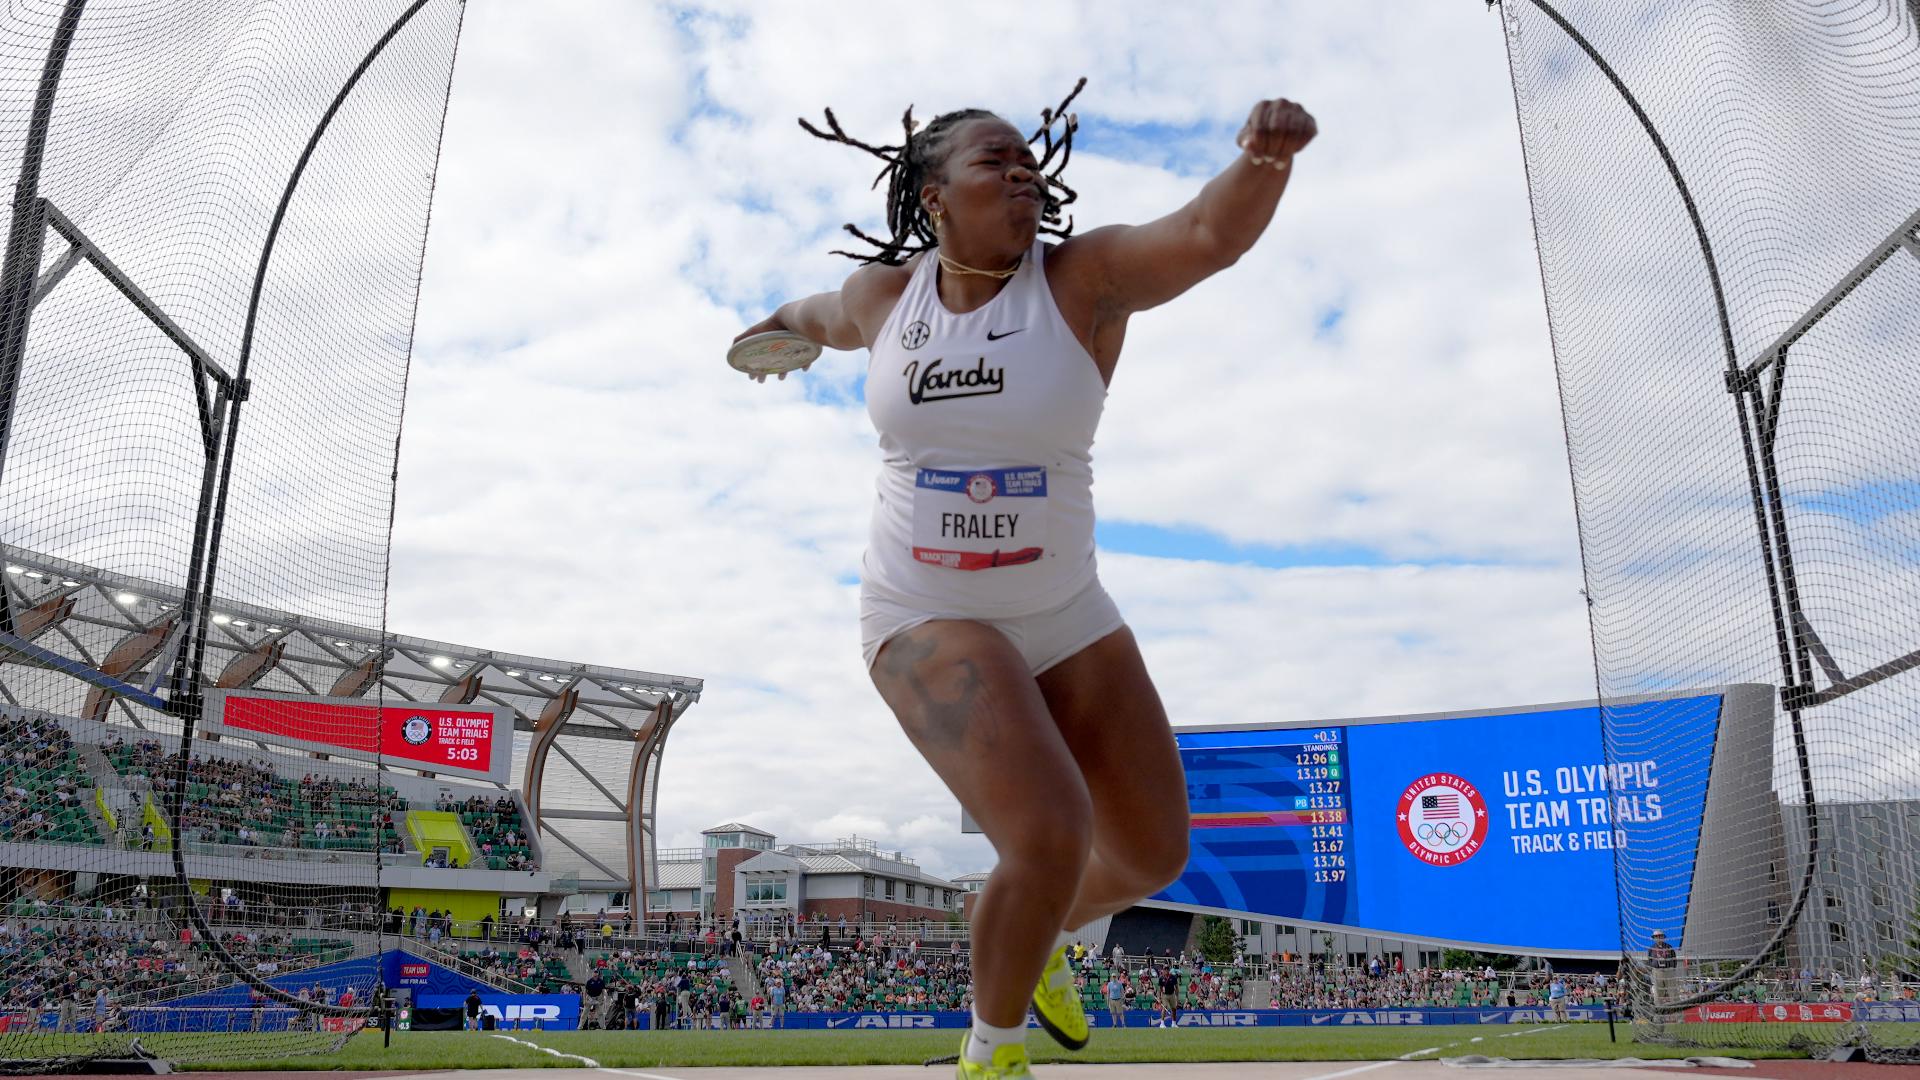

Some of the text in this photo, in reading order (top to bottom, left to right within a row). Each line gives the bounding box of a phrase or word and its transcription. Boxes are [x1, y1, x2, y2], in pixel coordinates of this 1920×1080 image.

[903, 357, 1004, 405] Vandy
[941, 512, 1019, 538] FRALEY
[438, 717, 490, 728] U.S. OLYMPIC
[438, 727, 489, 738] TEAM TRIALS
[1313, 731, 1337, 742] +0.3
[447, 747, 478, 760] 5:03
[1303, 743, 1338, 752] STANDINGS
[1295, 753, 1327, 765] 12.96
[1296, 767, 1328, 780] 13.19
[1503, 760, 1659, 798] U.S. OLYMPIC
[1309, 781, 1340, 794] 13.27
[1404, 775, 1476, 801] UNITED STATES
[1310, 795, 1342, 808] 13.33
[1311, 811, 1343, 823] 13.38
[1505, 794, 1663, 829] TEAM TRIALS
[1312, 825, 1343, 838] 13.41
[1313, 840, 1344, 853] 13.67
[1511, 830, 1627, 854] TRACK & FIELD
[1409, 839, 1479, 864] OLYMPIC TEAM
[1313, 855, 1345, 868] 13.76
[1314, 870, 1346, 882] 13.97
[476, 1004, 561, 1022] AIR
[1177, 1013, 1258, 1026] AIR
[1340, 1011, 1424, 1024] AIR
[854, 1014, 935, 1028] AIR
